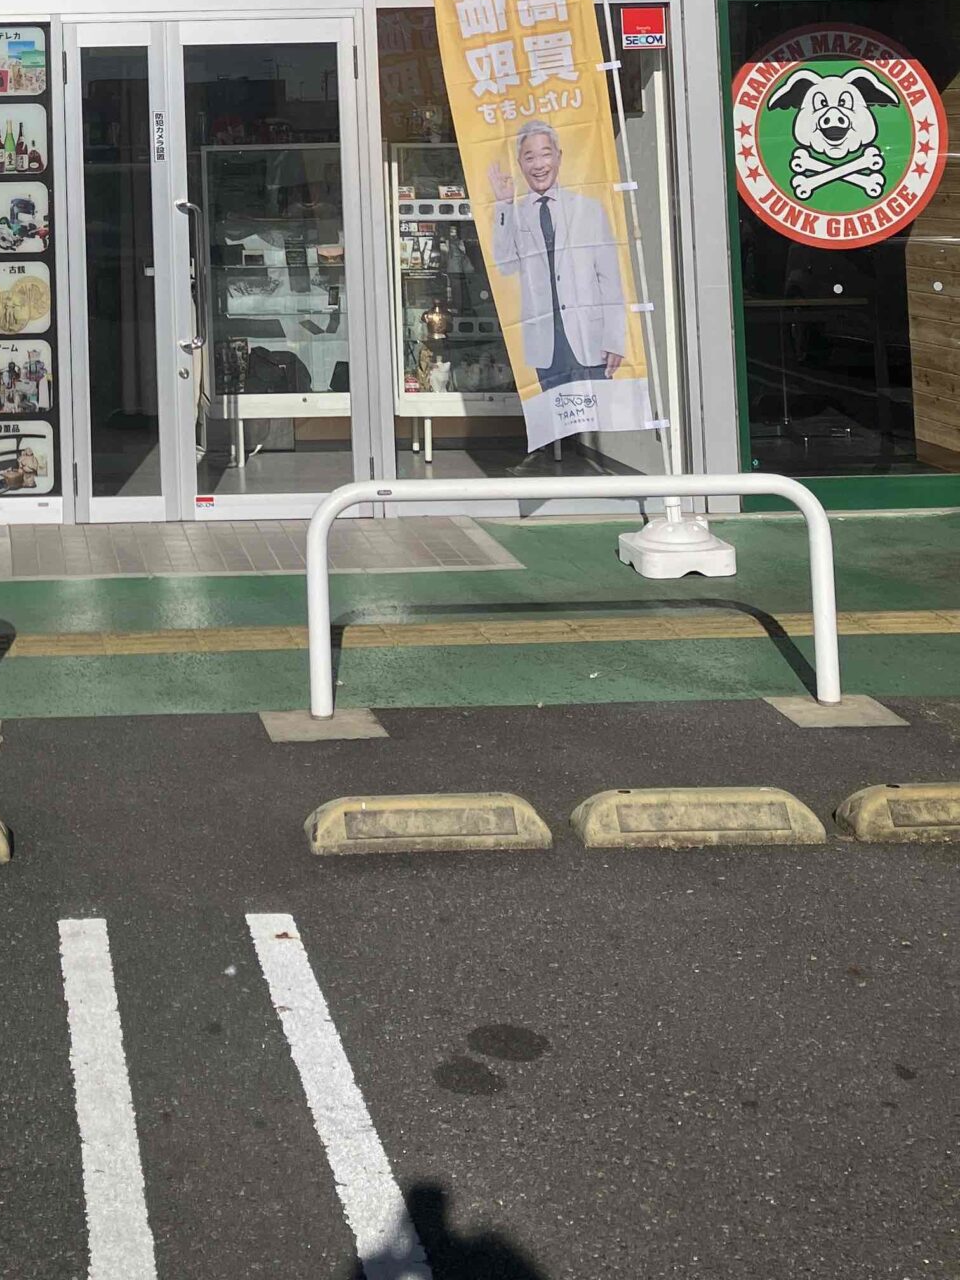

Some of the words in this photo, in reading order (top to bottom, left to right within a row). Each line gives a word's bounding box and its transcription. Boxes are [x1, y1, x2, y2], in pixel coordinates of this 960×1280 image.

[625, 35, 663, 45] SECOM
[738, 38, 807, 111] RAMEN
[811, 32, 928, 108] MAZESOBA
[758, 187, 820, 235] JUNK
[826, 184, 919, 238] GARAGE
